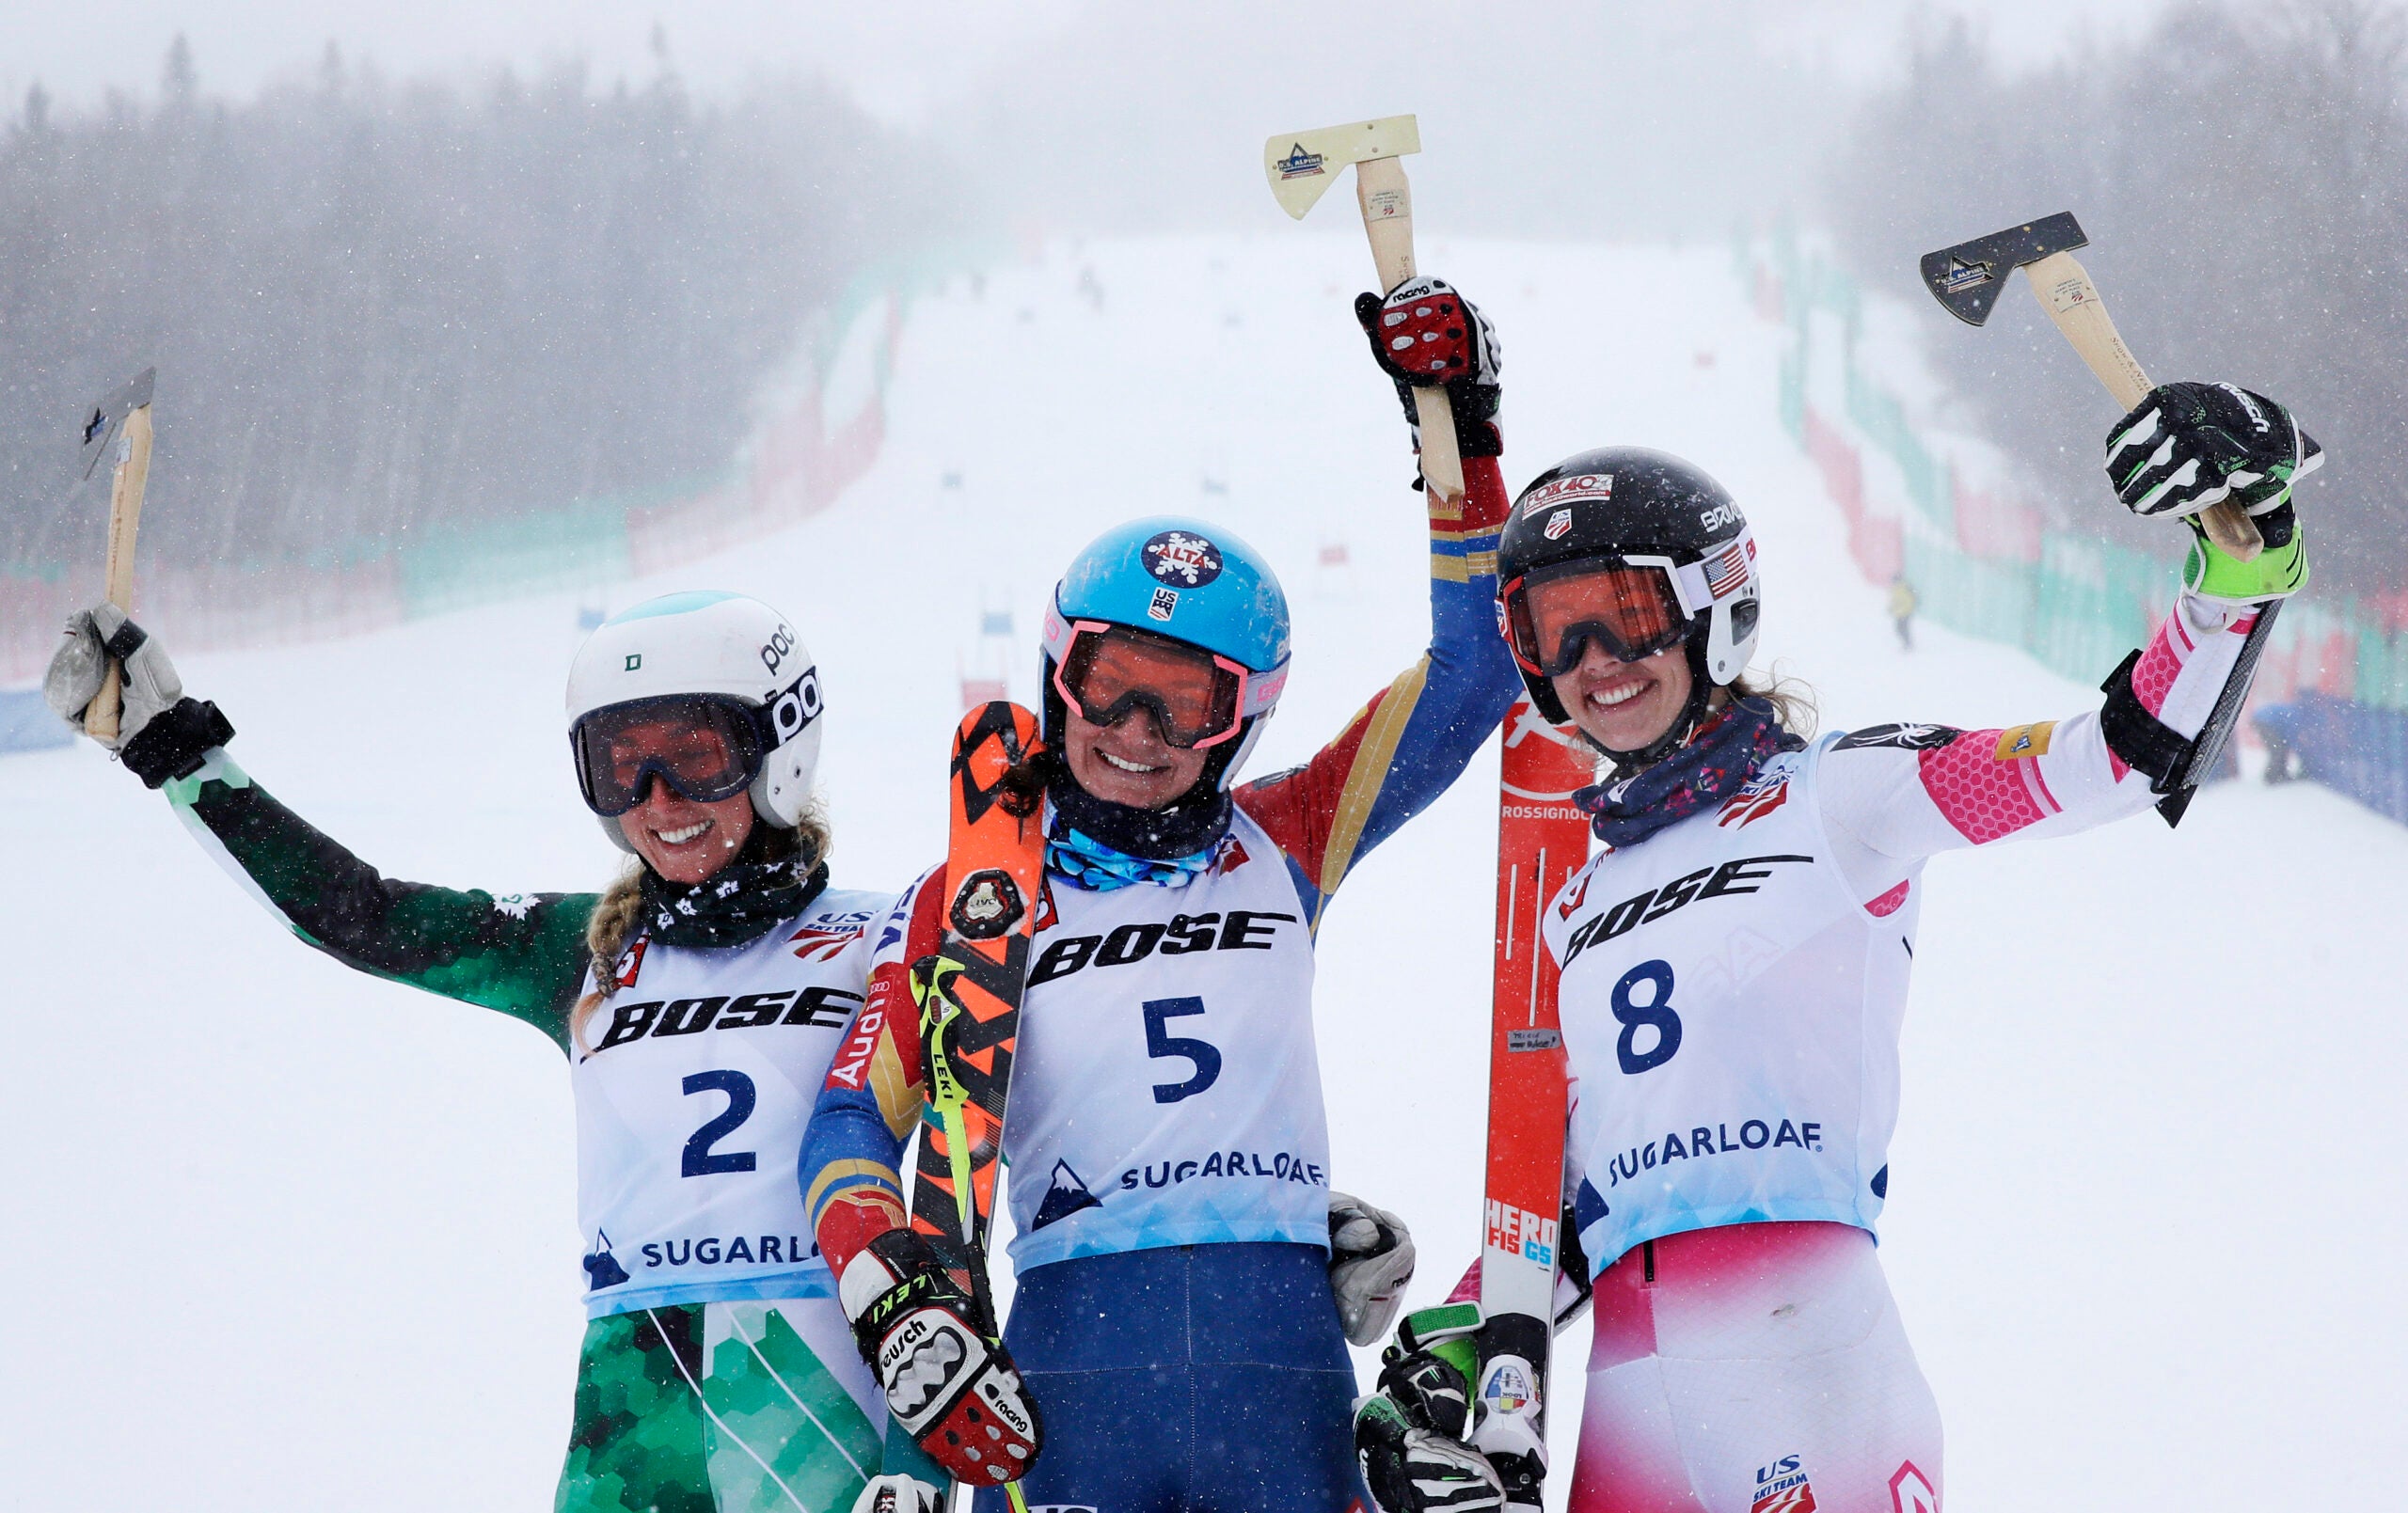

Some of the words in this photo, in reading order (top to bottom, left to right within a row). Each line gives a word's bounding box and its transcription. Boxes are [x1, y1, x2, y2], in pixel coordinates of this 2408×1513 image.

[1393, 285, 1431, 303] racing
[1157, 544, 1206, 569] ALTA
[1155, 589, 1177, 603] US
[760, 623, 795, 677] poc
[772, 674, 823, 746] po
[1502, 806, 1590, 820] ROSSIGNOL
[804, 923, 832, 932] SKI
[816, 910, 875, 923] US
[1562, 854, 1814, 969] BOSE
[1026, 910, 1297, 989] BOSE
[579, 985, 865, 1064] BOSE
[1610, 959, 1683, 1075] 8
[832, 999, 886, 1087] Audi
[1141, 995, 1222, 1104] 5
[933, 1053, 954, 1100] LEKI
[681, 1069, 757, 1178] 2
[1121, 1151, 1324, 1190] SUGARLOAF
[1608, 1119, 1821, 1189] SUGARLOAF
[1486, 1197, 1558, 1246] HERO
[1488, 1227, 1520, 1255] FIS
[1525, 1240, 1551, 1266] GS
[873, 1274, 927, 1325] LEKI
[994, 1399, 1028, 1433] racing
[1753, 1485, 1771, 1503] SKI
[1773, 1473, 1808, 1491] TEAM
[1756, 1454, 1800, 1484] US
